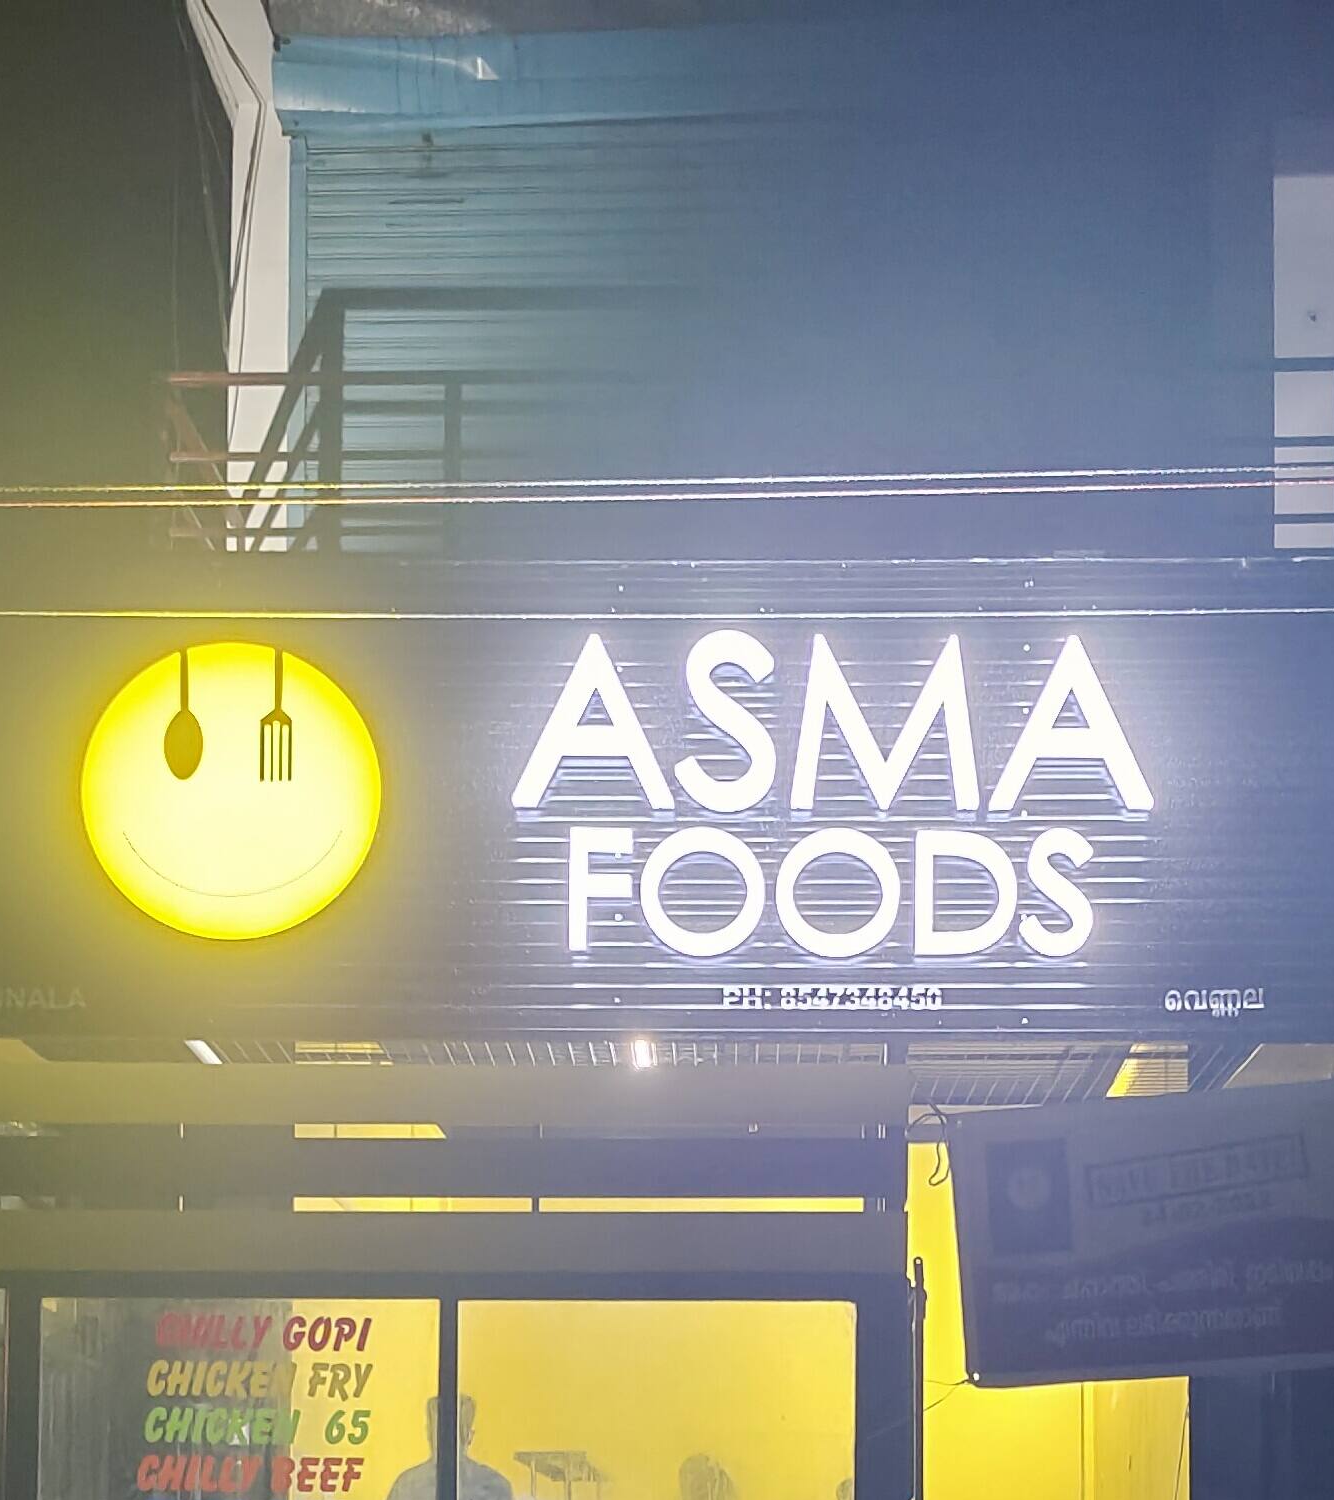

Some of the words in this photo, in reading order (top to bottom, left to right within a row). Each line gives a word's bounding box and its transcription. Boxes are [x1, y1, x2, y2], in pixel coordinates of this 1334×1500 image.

[512, 629, 1155, 812] ASMA
[568, 826, 1096, 959] FOODS
[723, 986, 772, 1010] PH:
[780, 986, 942, 1010] 8547348450
[1164, 988, 1264, 1017] വെണ്ണല
[156, 1314, 272, 1348] CHILLY
[282, 1317, 372, 1352] GOPI
[146, 1360, 296, 1399] CHICKEN
[308, 1362, 373, 1399] FRY
[144, 1407, 299, 1446] CHICKEN
[324, 1409, 371, 1445] 65
[136, 1455, 263, 1493] CHILLY
[271, 1457, 364, 1493] BEEF
